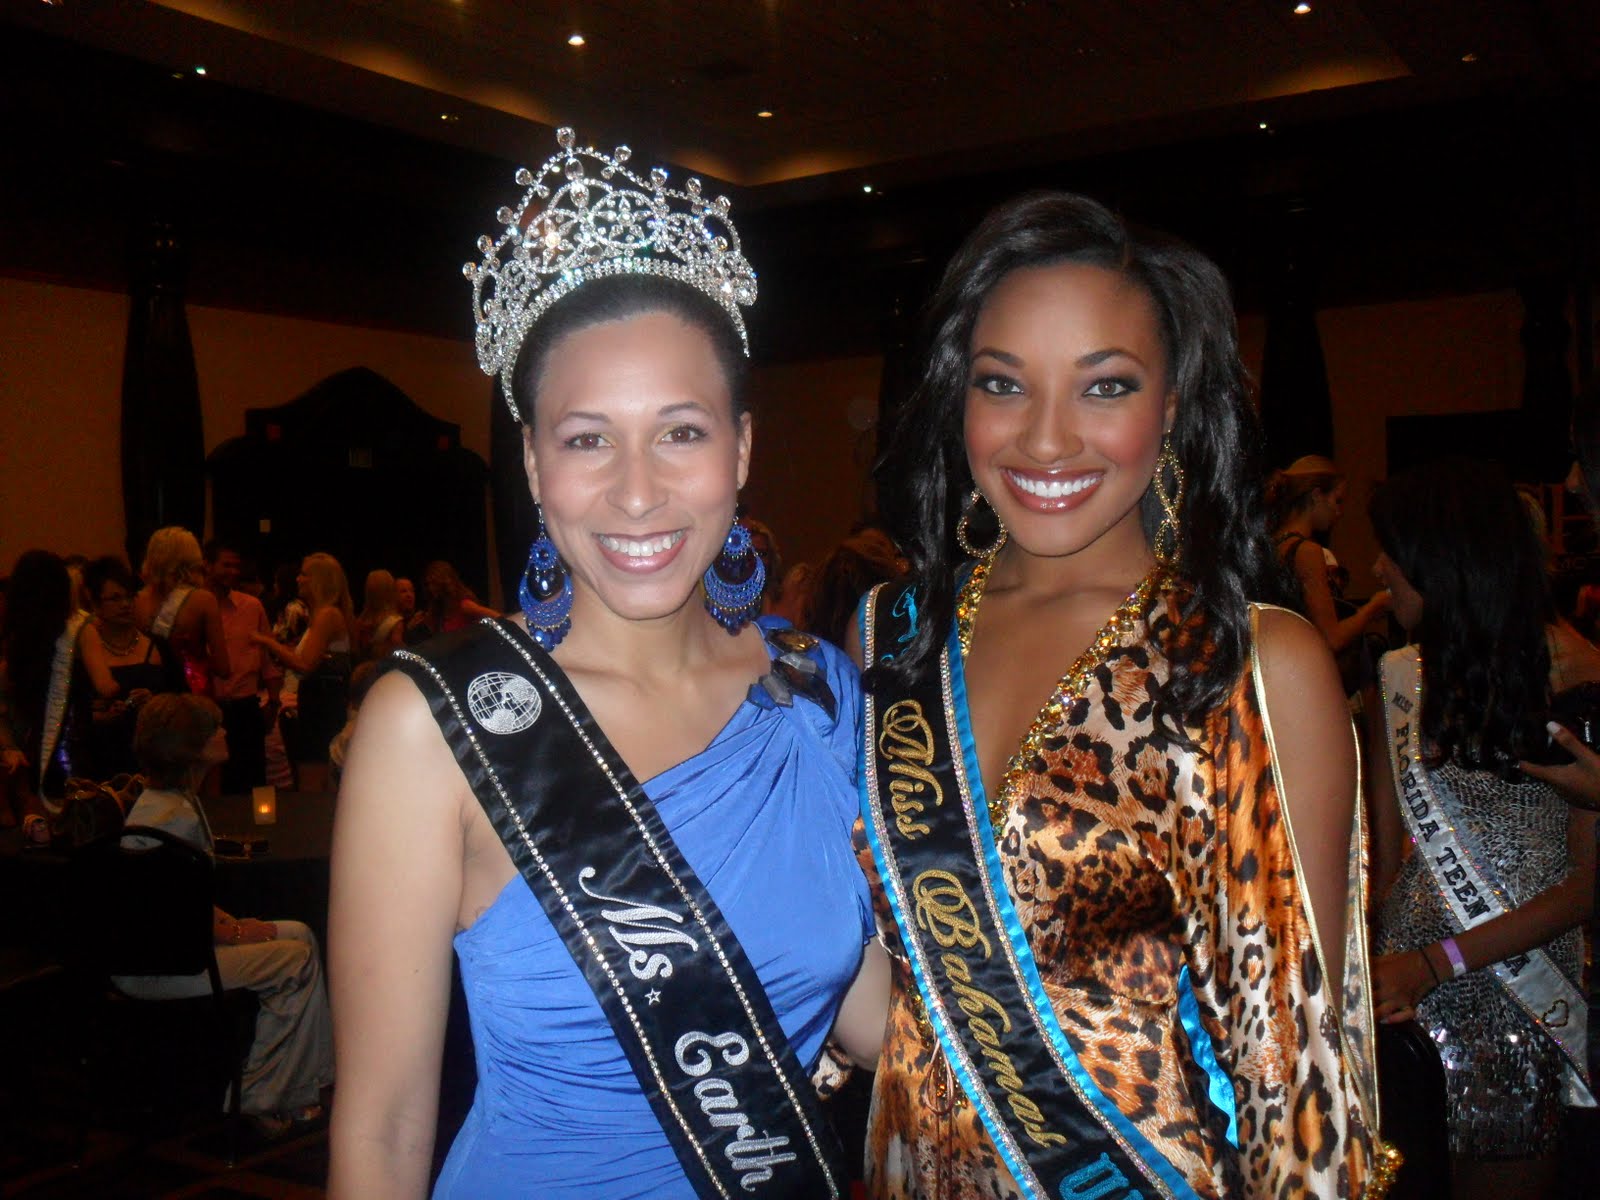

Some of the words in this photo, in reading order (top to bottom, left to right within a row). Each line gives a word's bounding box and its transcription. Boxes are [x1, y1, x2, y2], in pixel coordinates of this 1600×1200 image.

[879, 699, 944, 841] Miss
[912, 868, 1068, 1148] Bahamas
[1395, 722, 1441, 843] FLORIDA
[1435, 846, 1492, 920] TEEN
[578, 866, 699, 981] Ms
[674, 1031, 797, 1192] Earth
